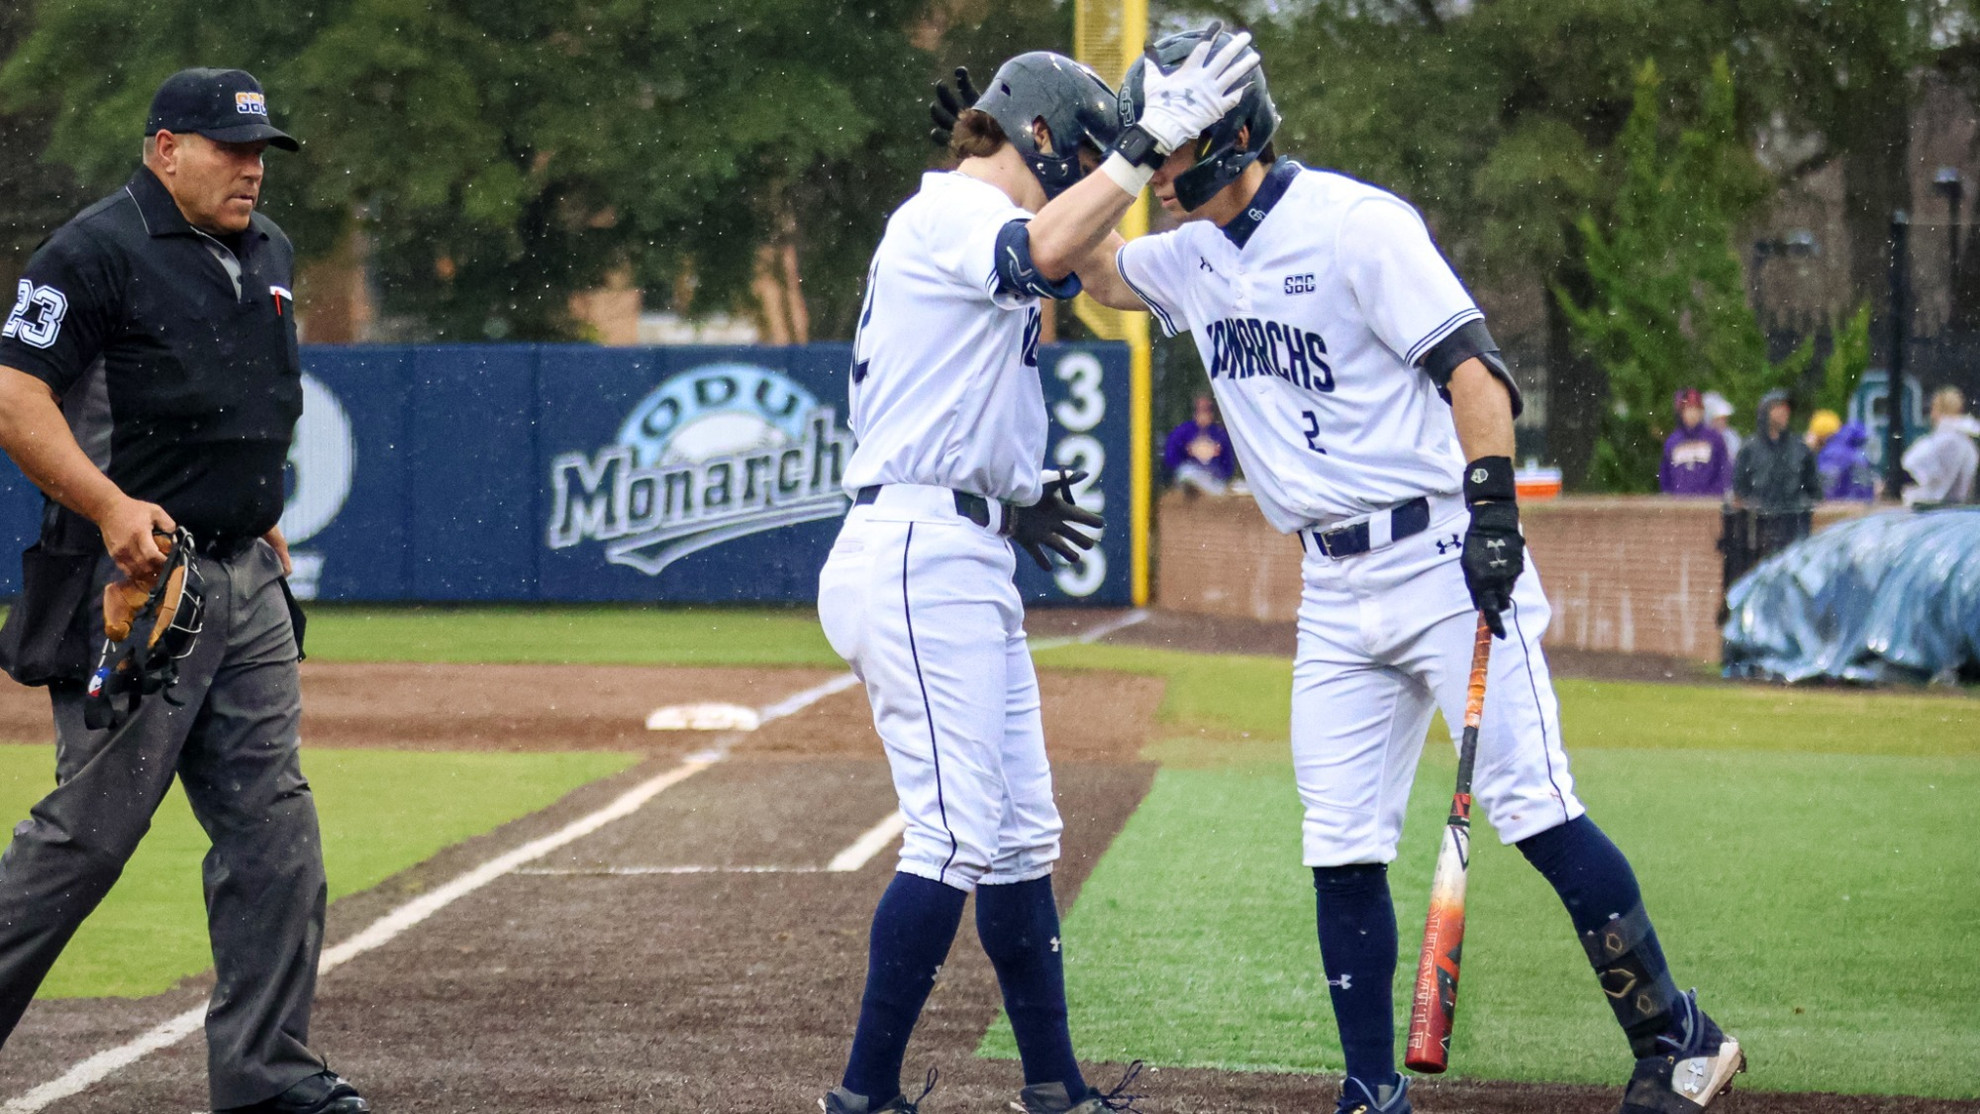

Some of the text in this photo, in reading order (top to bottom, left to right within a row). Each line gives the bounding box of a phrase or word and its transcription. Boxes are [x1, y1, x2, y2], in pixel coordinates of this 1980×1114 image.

[1, 279, 68, 349] 23
[1284, 274, 1315, 294] SBC
[1206, 318, 1335, 392] ONARCHS
[641, 373, 798, 439] ODU
[1302, 410, 1327, 455] 2
